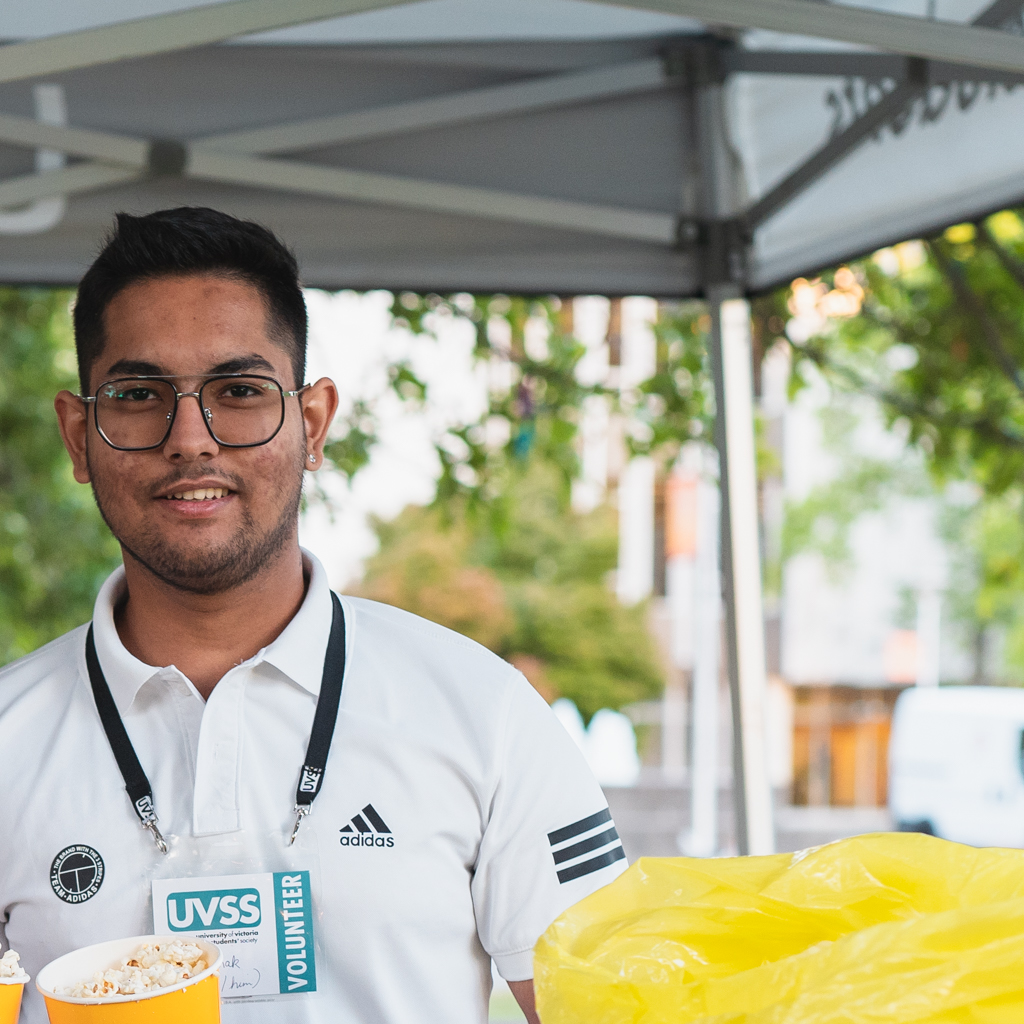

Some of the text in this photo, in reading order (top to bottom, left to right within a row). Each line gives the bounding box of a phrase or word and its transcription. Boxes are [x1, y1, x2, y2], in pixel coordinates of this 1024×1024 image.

[340, 834, 394, 848] adidas
[168, 894, 260, 928] UVSS
[281, 874, 308, 991] VOLUNTEER
